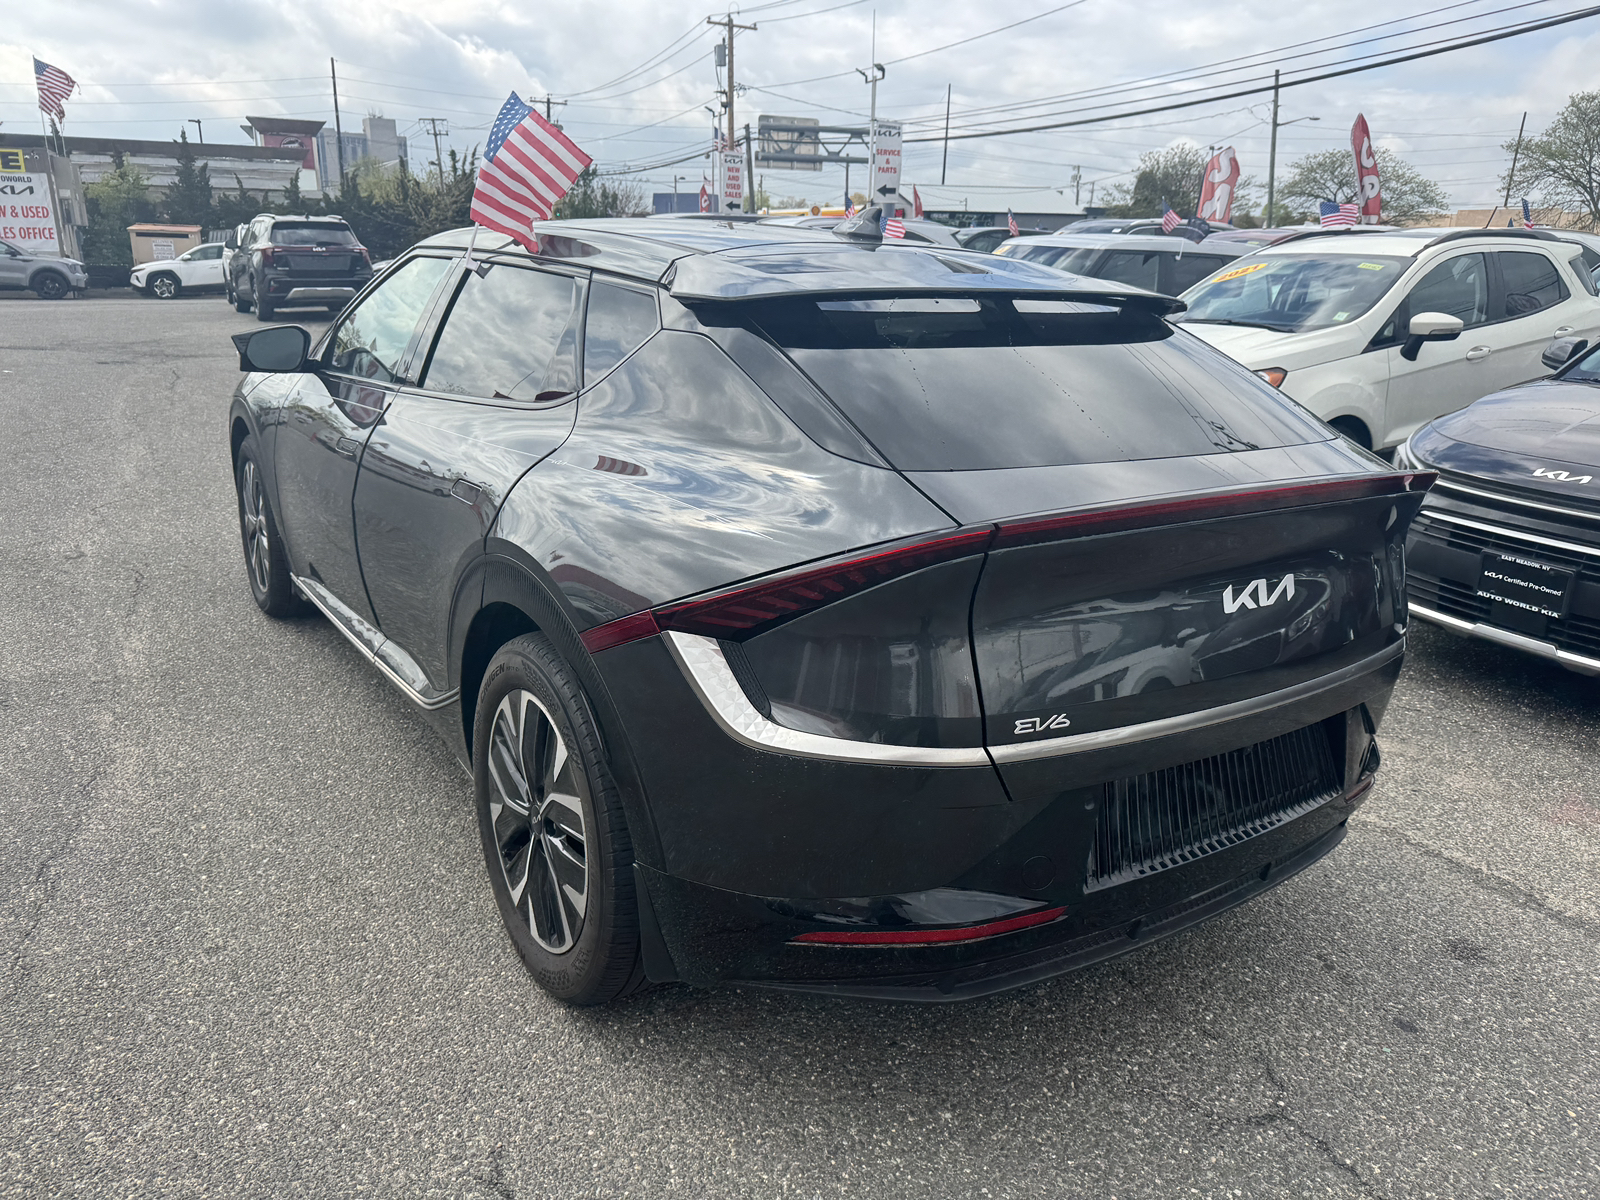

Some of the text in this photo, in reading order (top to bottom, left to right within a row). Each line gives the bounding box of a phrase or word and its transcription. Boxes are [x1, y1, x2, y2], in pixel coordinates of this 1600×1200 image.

[876, 148, 901, 156] SERVICE
[885, 157, 891, 165] &
[878, 166, 897, 174] PARTS
[728, 174, 740, 182] AND
[725, 191, 742, 199] SALES
[10, 205, 19, 218] &
[21, 206, 50, 219] USED
[18, 227, 55, 240] OFFICE
[1532, 467, 1593, 485] KIA
[1484, 571, 1562, 597] KIA Certified Pre-Owned
[1222, 573, 1295, 614] KIA
[1477, 590, 1560, 618] AUTO WORLD KIA
[1014, 713, 1071, 735] EV6
